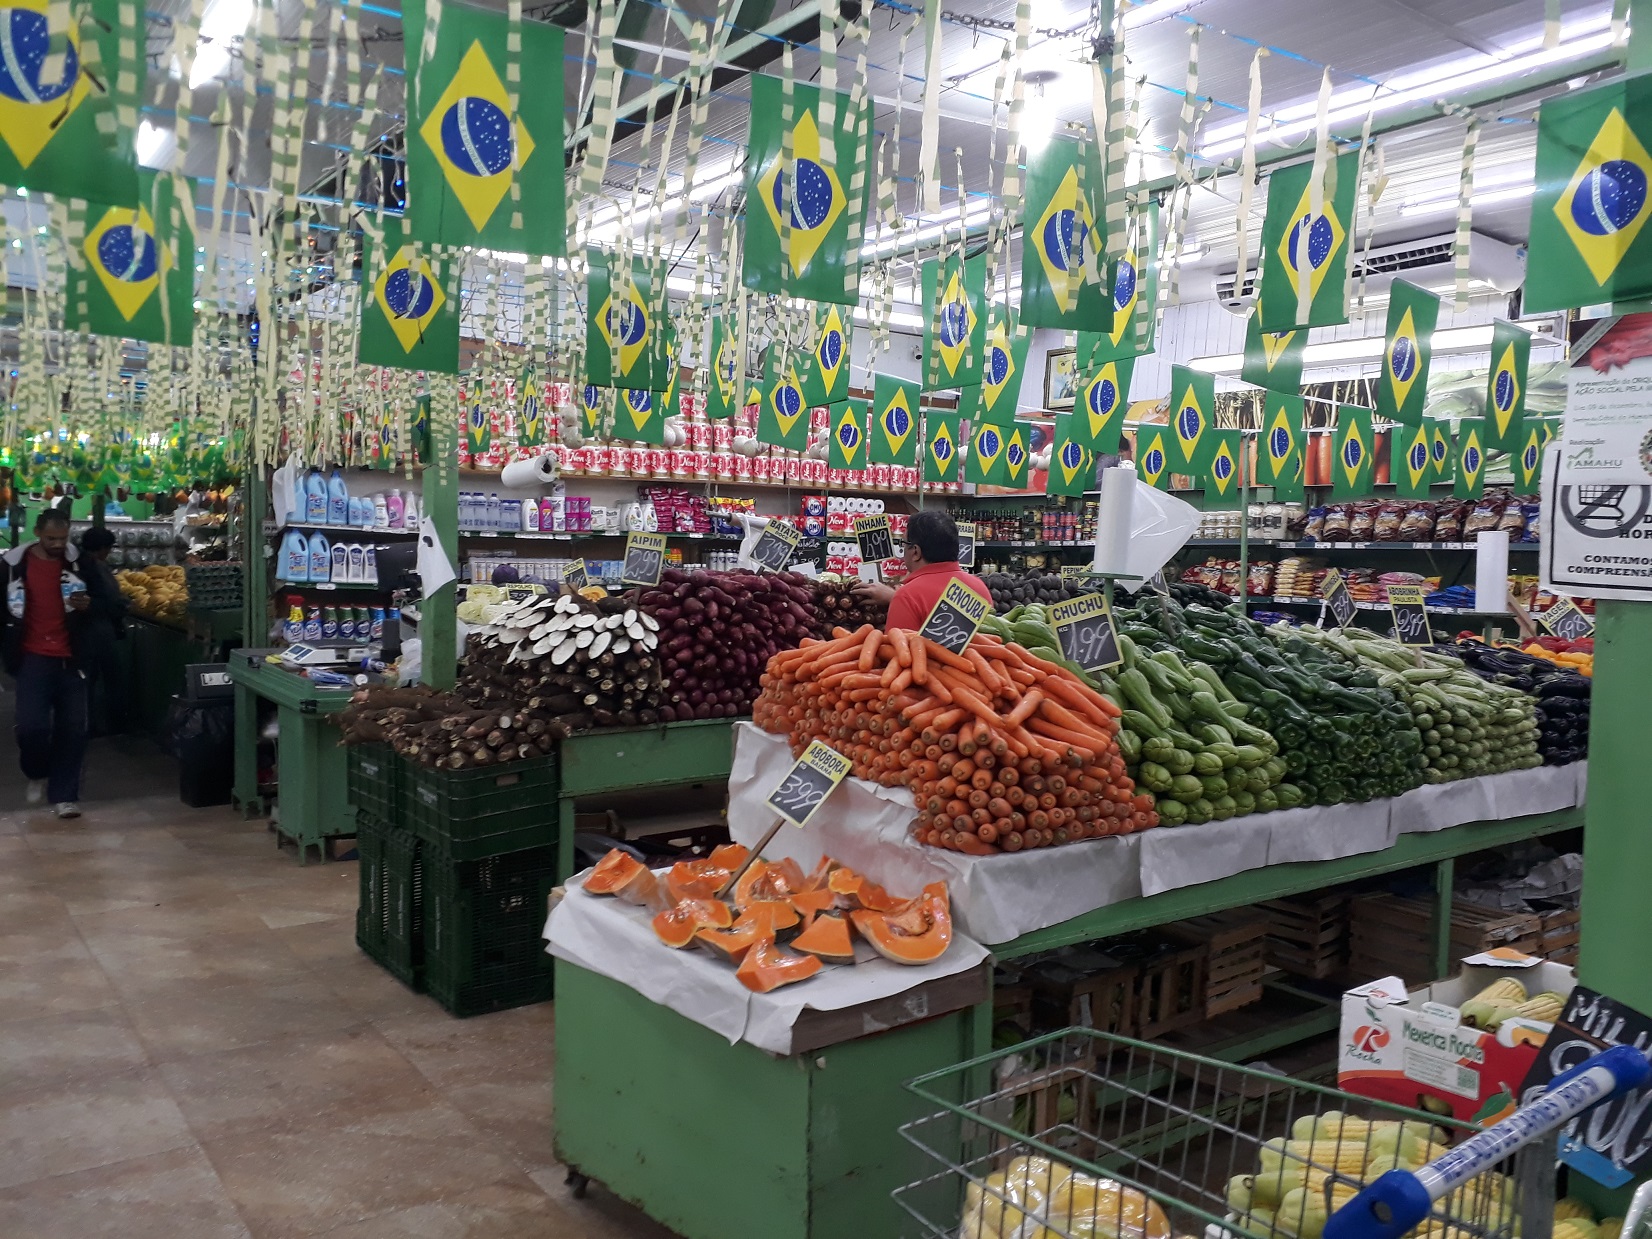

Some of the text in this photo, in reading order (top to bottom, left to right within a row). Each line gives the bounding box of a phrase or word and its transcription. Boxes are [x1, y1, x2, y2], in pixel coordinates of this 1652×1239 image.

[1574, 386, 1594, 396] AÇÃO
[1573, 459, 1623, 467] AMAHU
[810, 503, 821, 512] OMO
[827, 515, 844, 525] Neve
[855, 516, 887, 532] INHAME
[770, 519, 800, 541] BATATA
[808, 523, 820, 531] OMO
[630, 535, 662, 548] AIPIM
[826, 560, 842, 570] Neve
[883, 561, 899, 570] Neve
[1388, 587, 1420, 596] ABOBRINHA
[939, 603, 948, 611] KG
[945, 583, 986, 621] CENOURA
[1052, 596, 1104, 621] CHUCHU
[1540, 599, 1570, 622] VAGEM
[808, 745, 846, 775] ABÓBORA
[1344, 1044, 1382, 1065] Rocha
